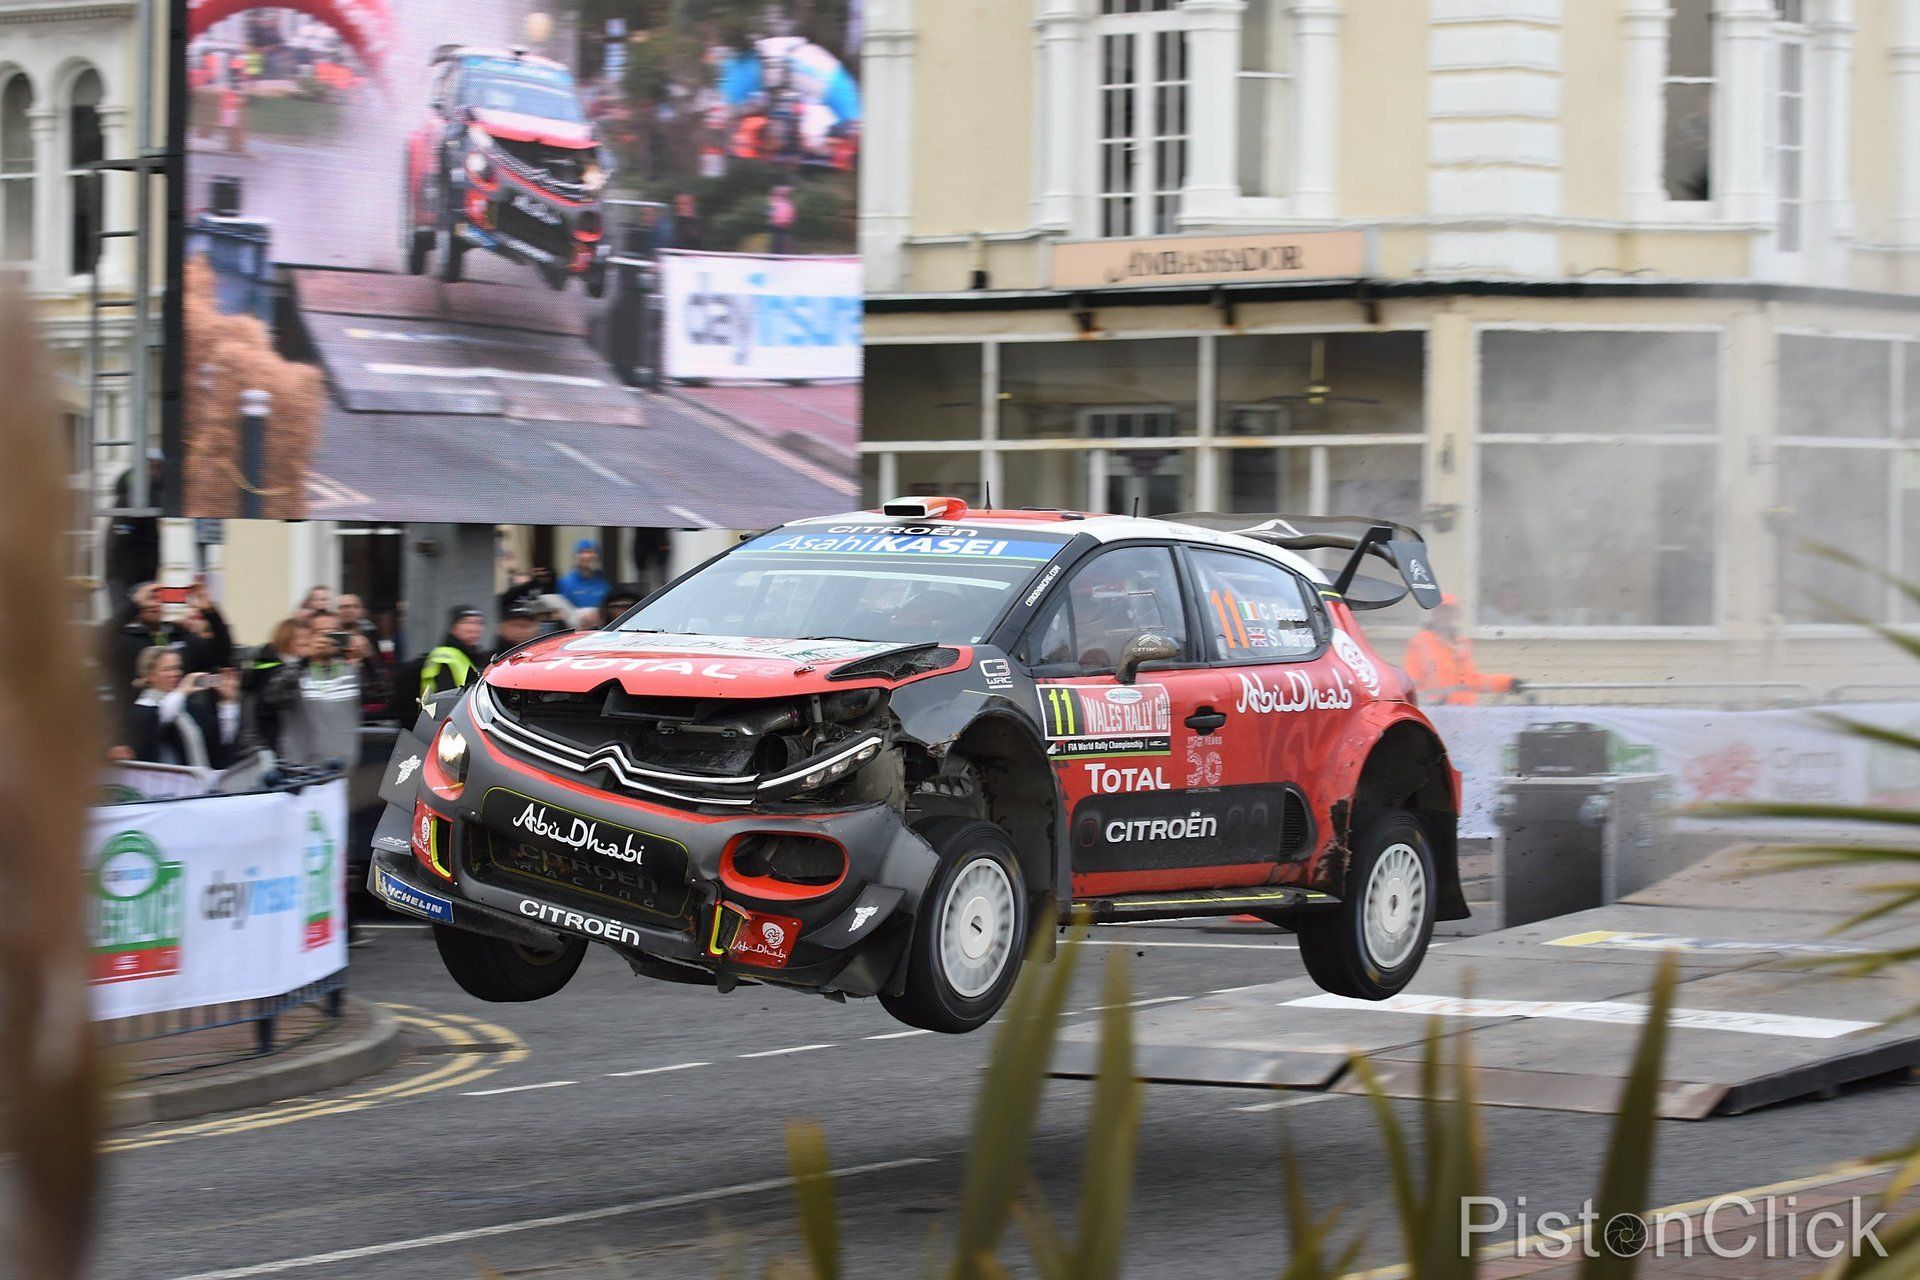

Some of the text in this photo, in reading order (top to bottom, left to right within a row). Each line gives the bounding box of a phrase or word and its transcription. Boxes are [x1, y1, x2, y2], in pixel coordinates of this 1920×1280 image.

[1210, 590, 1250, 649] 11
[544, 656, 738, 679] TOTAL
[986, 676, 1013, 684] WRC
[1048, 688, 1075, 735] 11
[1081, 695, 1122, 732] WALES
[1123, 699, 1153, 731] RALLY
[1067, 742, 1078, 751] FIA
[1078, 742, 1094, 751] World
[1095, 741, 1108, 751] Rally
[1109, 740, 1144, 750] Championship
